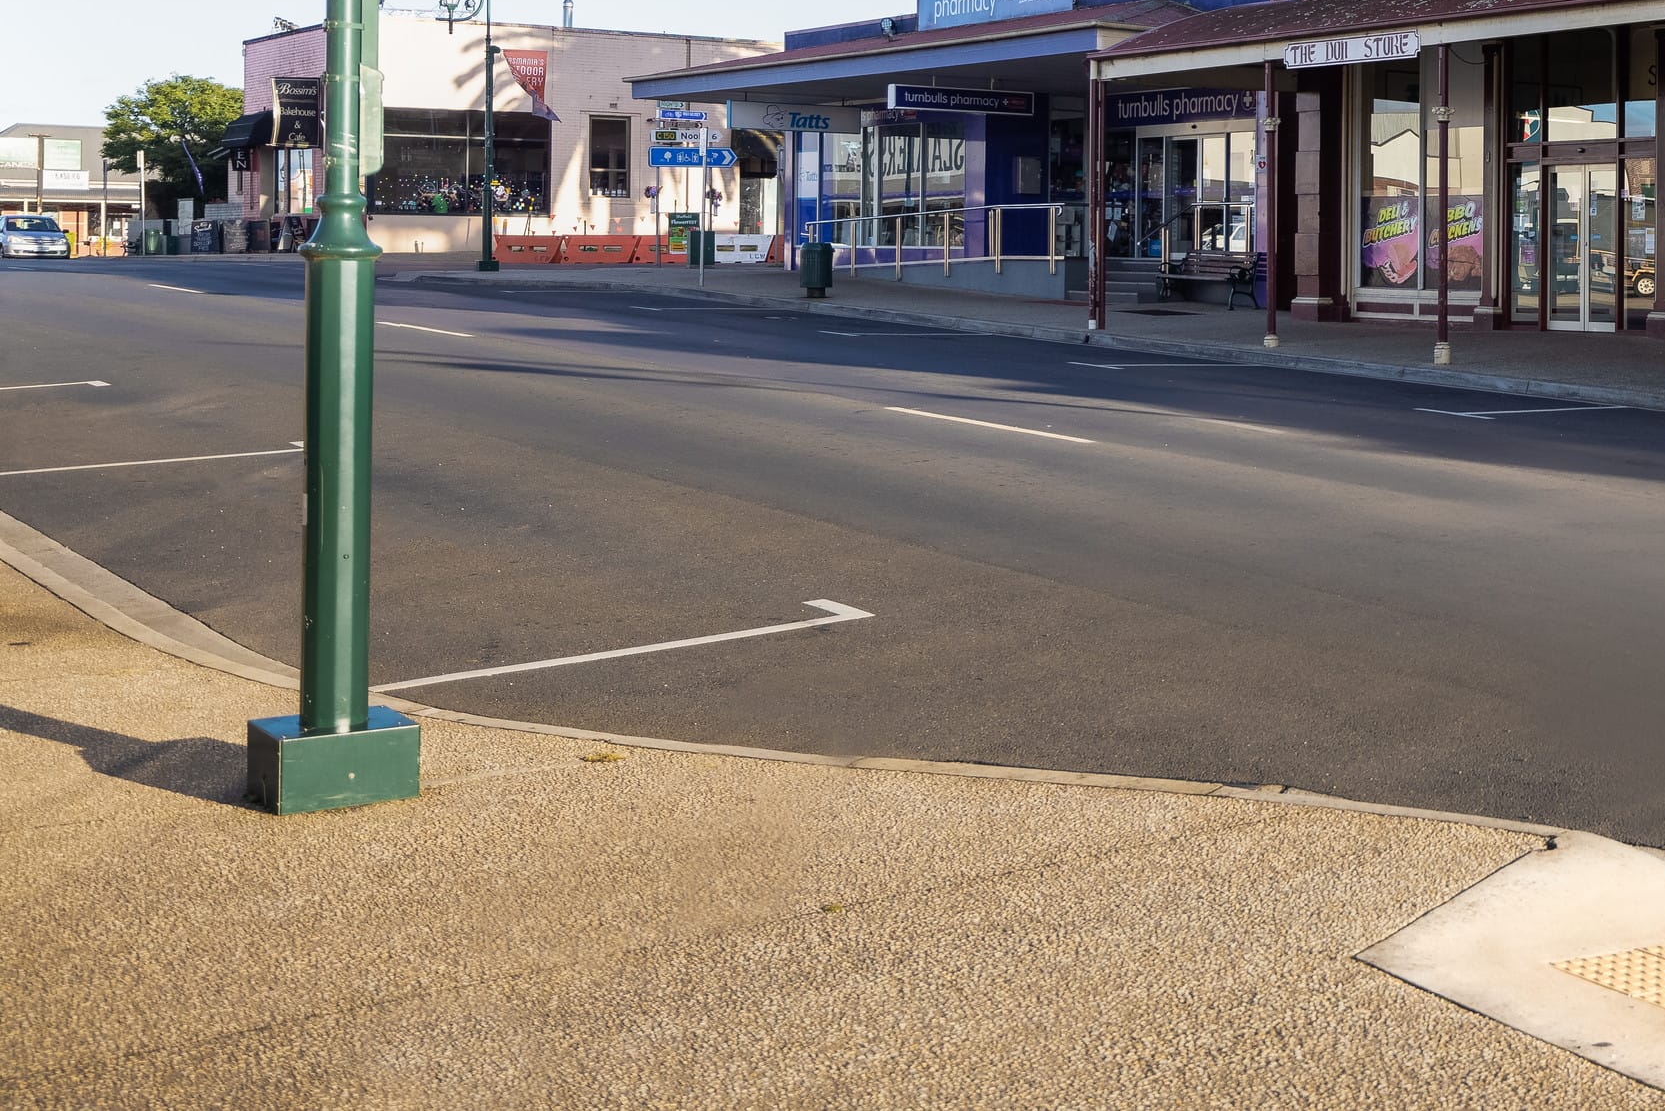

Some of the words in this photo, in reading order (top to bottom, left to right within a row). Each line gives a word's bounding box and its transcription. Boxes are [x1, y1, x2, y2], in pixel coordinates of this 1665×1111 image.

[1290, 44, 1316, 64] THE
[1364, 34, 1409, 58] STORE
[505, 57, 545, 66] ASMANIA'S
[904, 91, 948, 105] turnbulls
[950, 95, 1000, 108] pharmacy
[280, 106, 317, 117] Bakehouse
[1118, 93, 1170, 119] turnbulls
[1173, 93, 1239, 121] pharmacy
[294, 120, 302, 129] &
[789, 112, 830, 129] Tatts
[288, 132, 306, 142] Cafe
[681, 132, 700, 140] Noo
[1362, 217, 1417, 246] BUTCHERY
